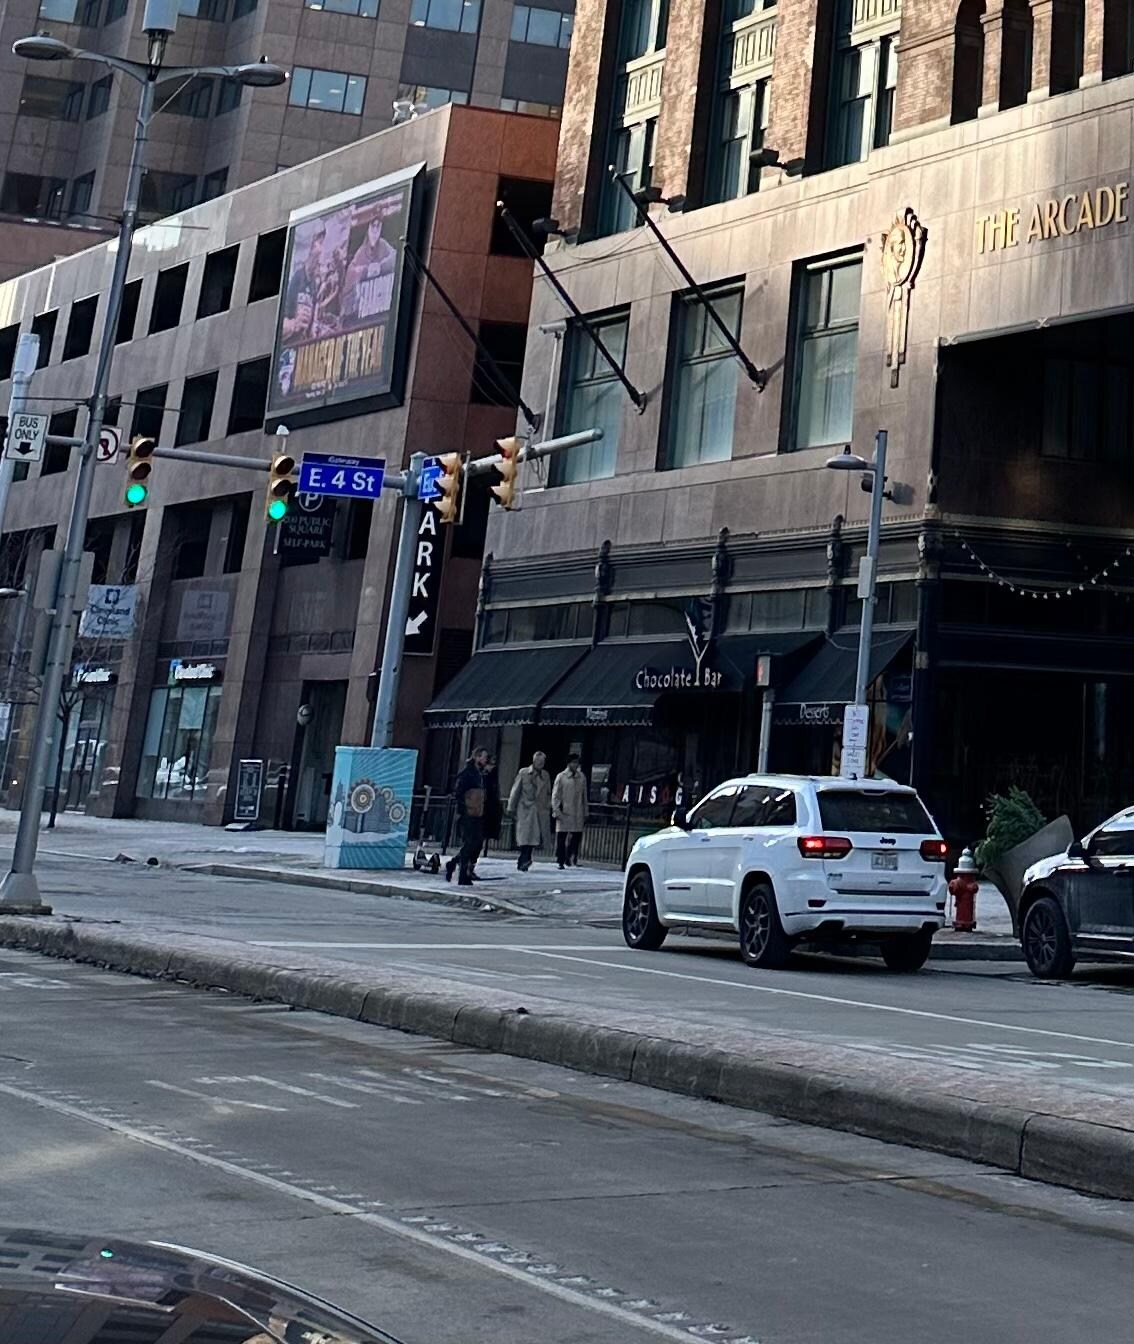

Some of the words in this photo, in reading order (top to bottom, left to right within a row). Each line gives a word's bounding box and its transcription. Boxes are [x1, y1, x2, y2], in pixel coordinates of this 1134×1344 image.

[975, 207, 1021, 254] THE
[1027, 181, 1129, 244] ARCADE
[19, 416, 39, 429] BUS
[14, 428, 40, 441] ONLY
[309, 467, 326, 488] E.
[331, 469, 346, 489] 4
[351, 471, 376, 492] St
[289, 524, 323, 535] SQUARE
[299, 516, 331, 527] PUBLIC
[411, 496, 437, 598] ARK
[635, 666, 692, 689] Chocolate
[703, 667, 722, 688] Bar
[800, 703, 830, 719] Desserts
